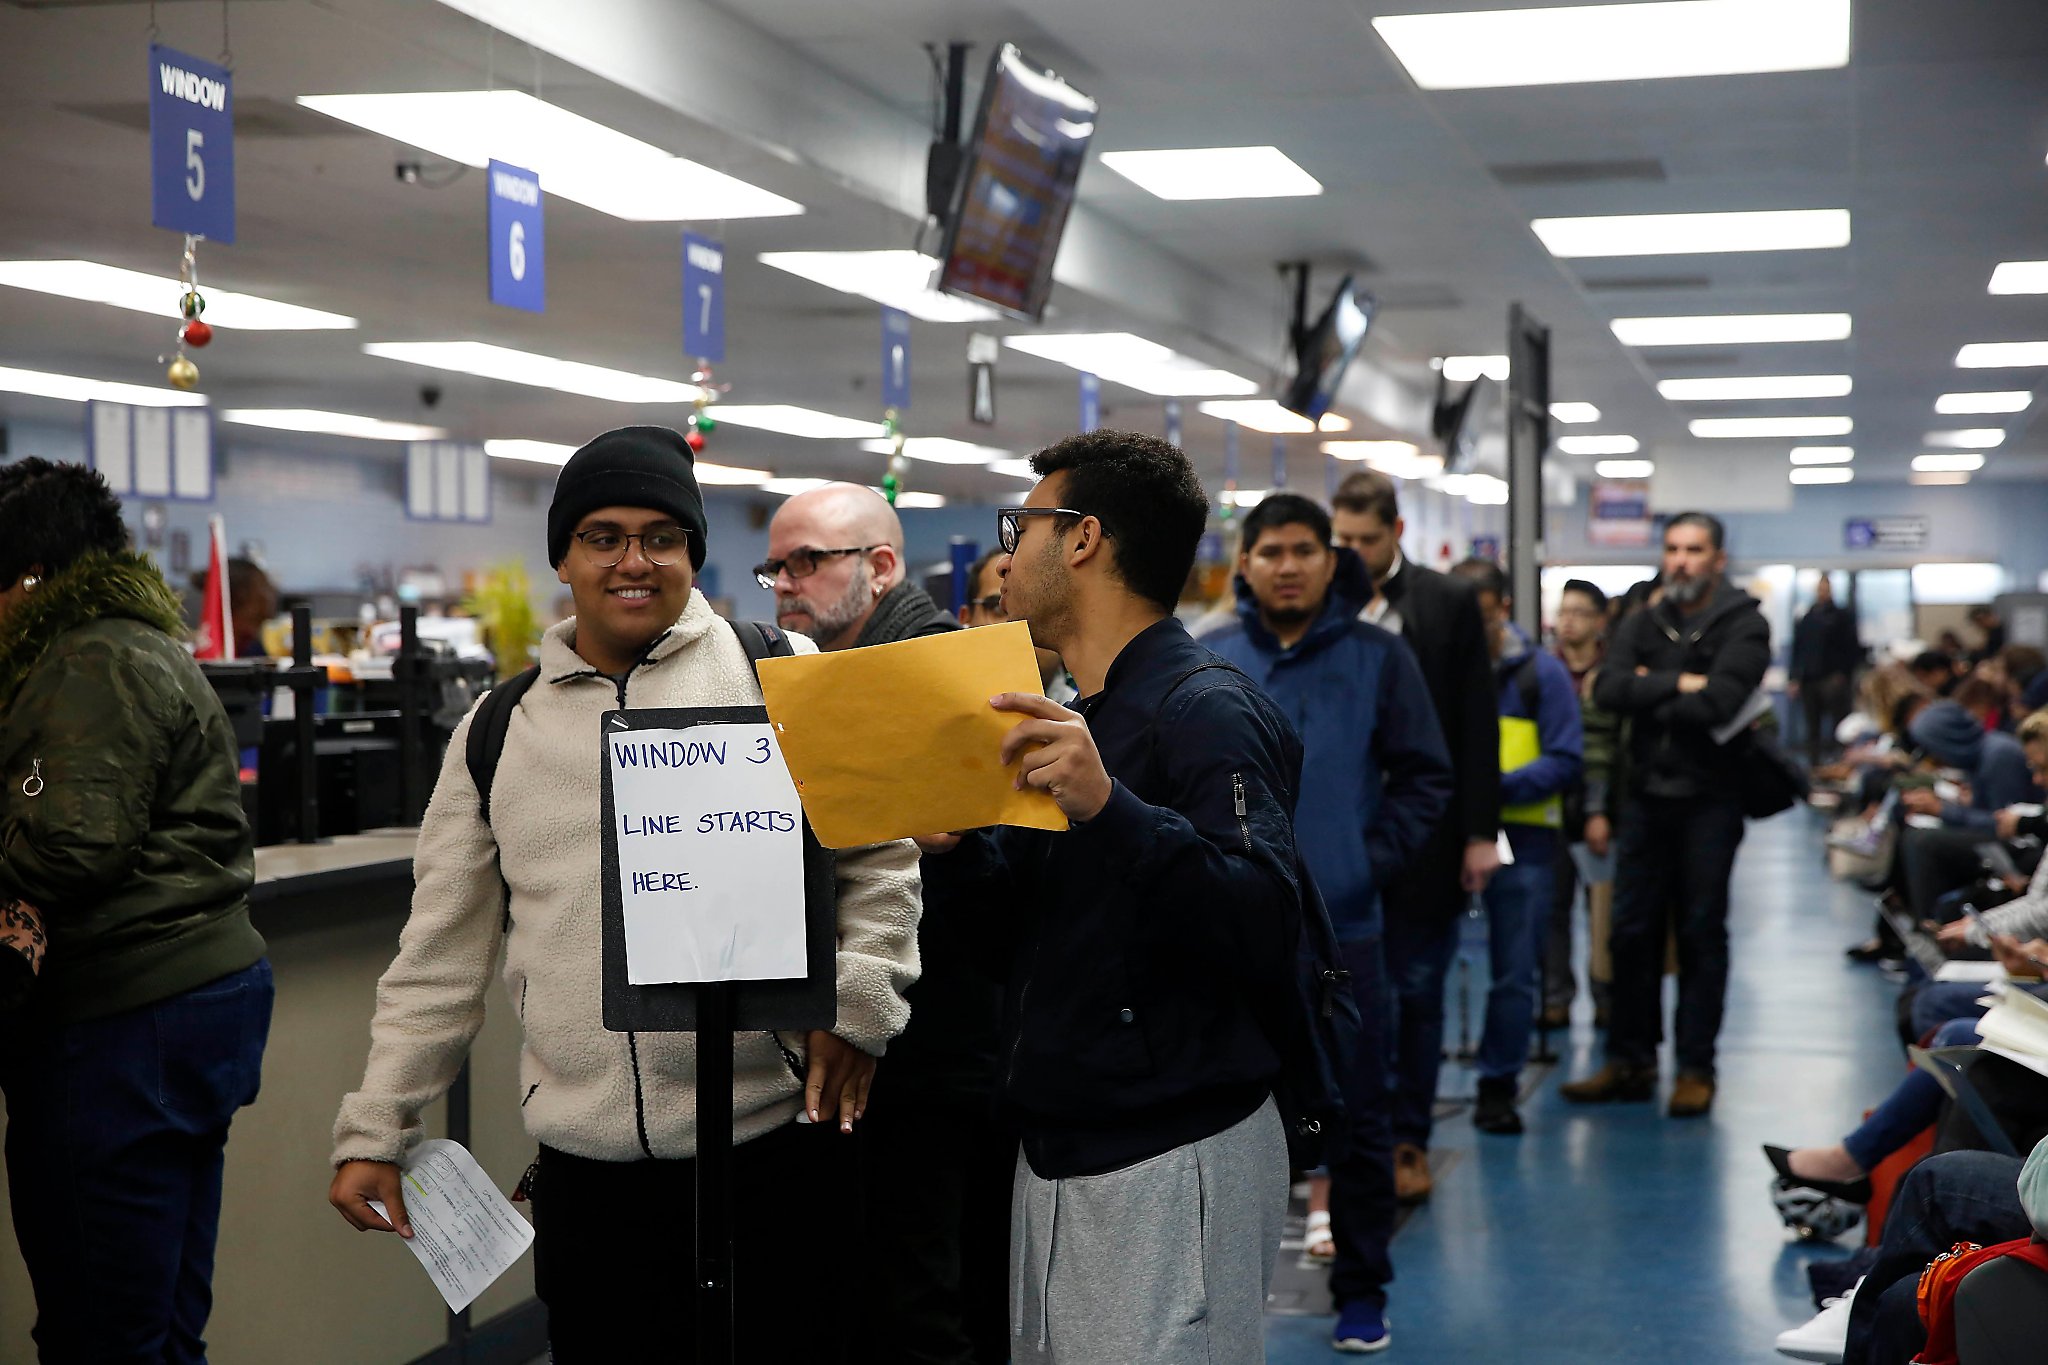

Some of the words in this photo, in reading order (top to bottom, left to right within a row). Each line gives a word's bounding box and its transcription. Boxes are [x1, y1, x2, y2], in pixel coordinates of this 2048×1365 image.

[160, 62, 226, 112] WINDOW
[186, 128, 206, 202] 5
[509, 220, 526, 282] 6
[698, 284, 713, 335] 7
[614, 741, 727, 768] WINDOW
[745, 737, 772, 764] 3
[624, 814, 682, 836] LINE
[697, 810, 796, 833] STARTS
[632, 871, 699, 894] HERE.
